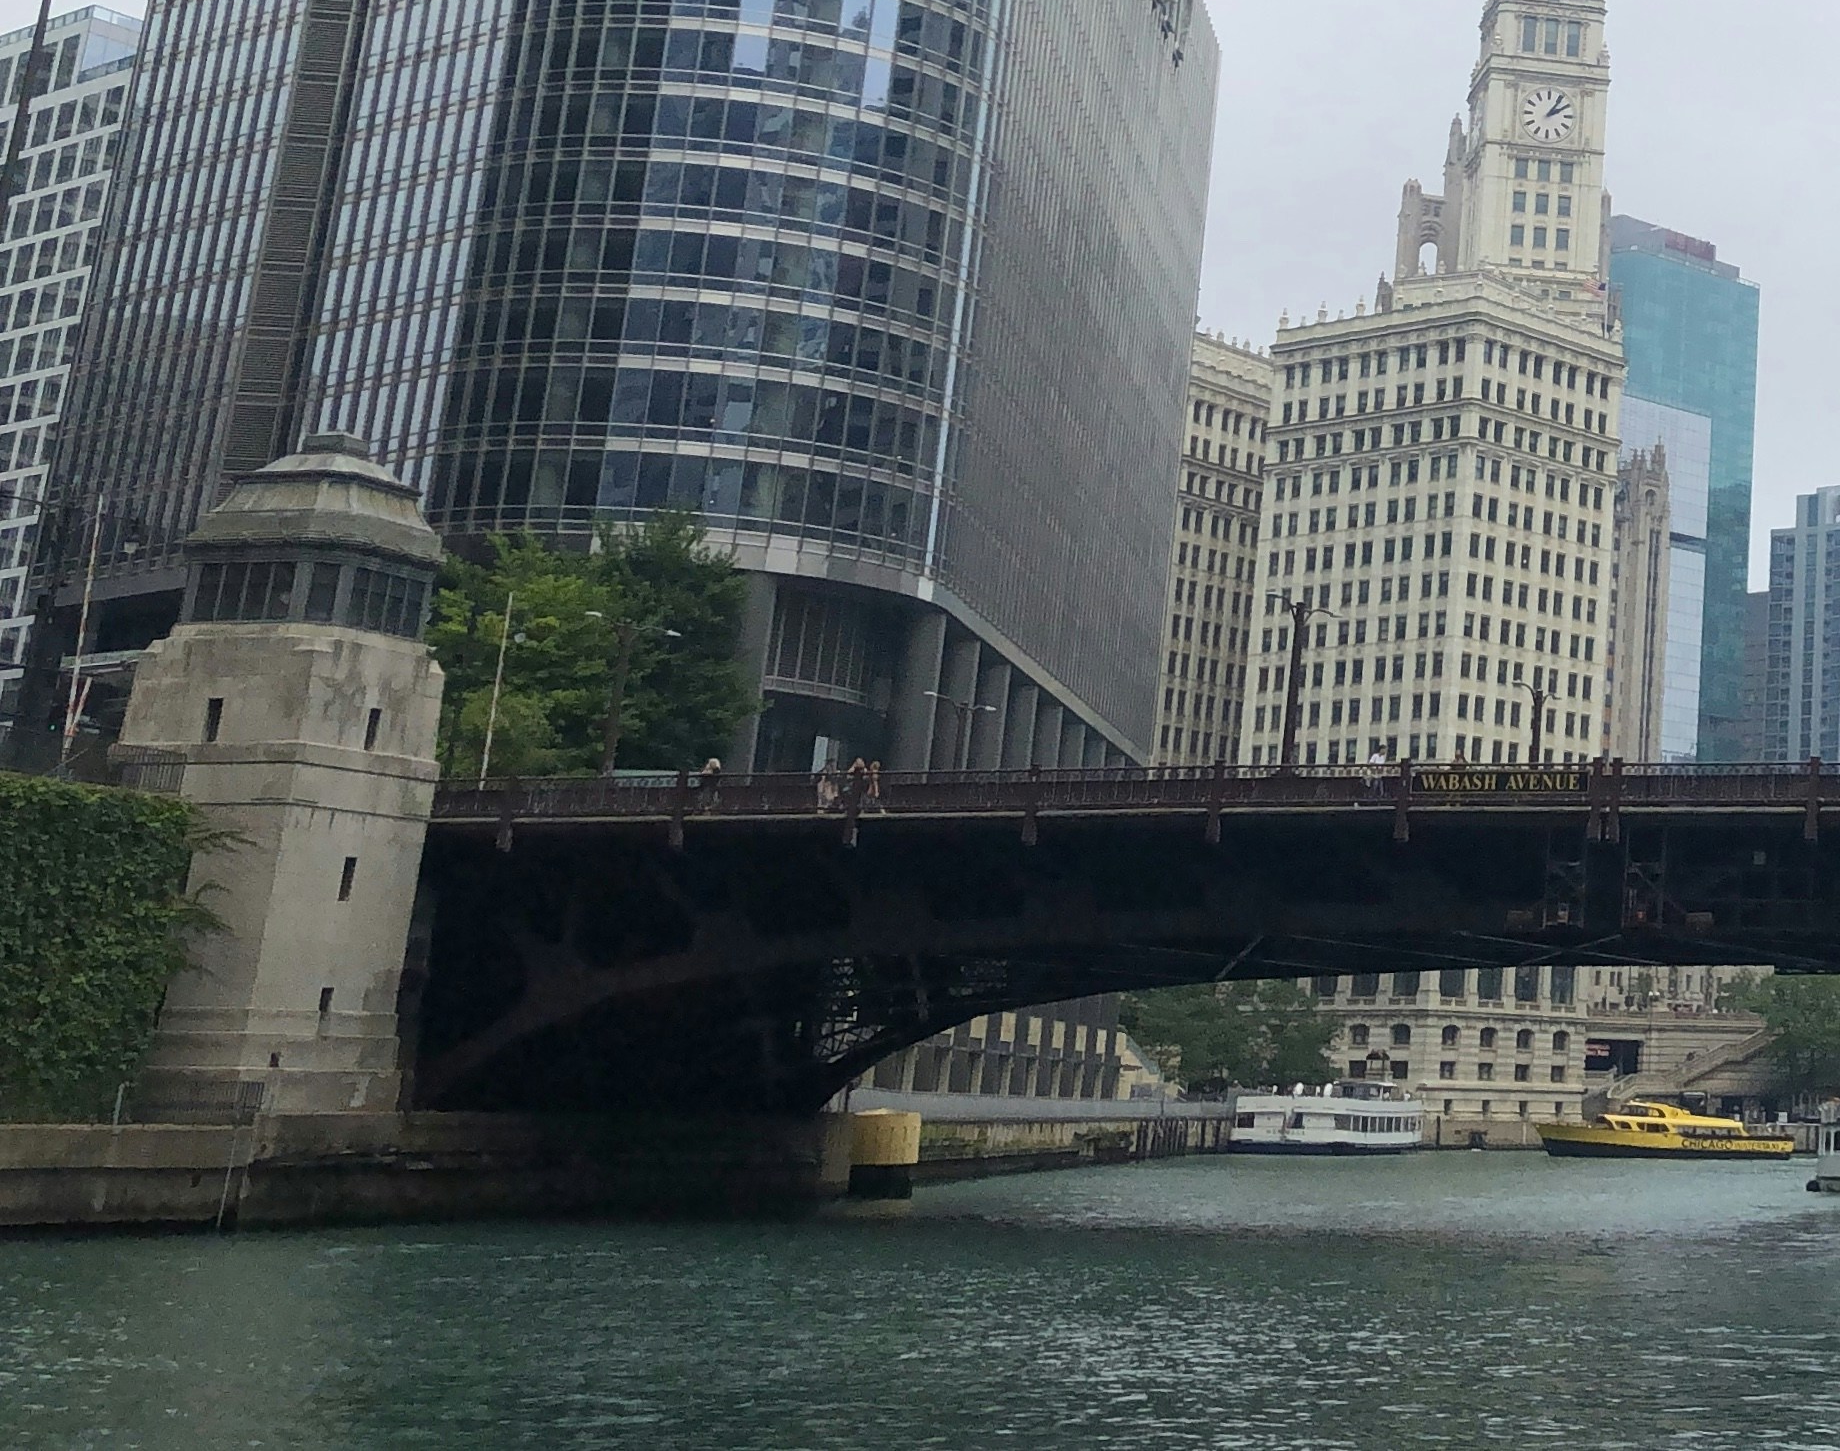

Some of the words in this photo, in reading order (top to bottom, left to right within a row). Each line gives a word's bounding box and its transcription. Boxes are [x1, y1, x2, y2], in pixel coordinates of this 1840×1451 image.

[1421, 774, 1497, 790] WABASH
[1505, 773, 1580, 790] AVENUE
[1681, 1139, 1733, 1149] CHICAGO
